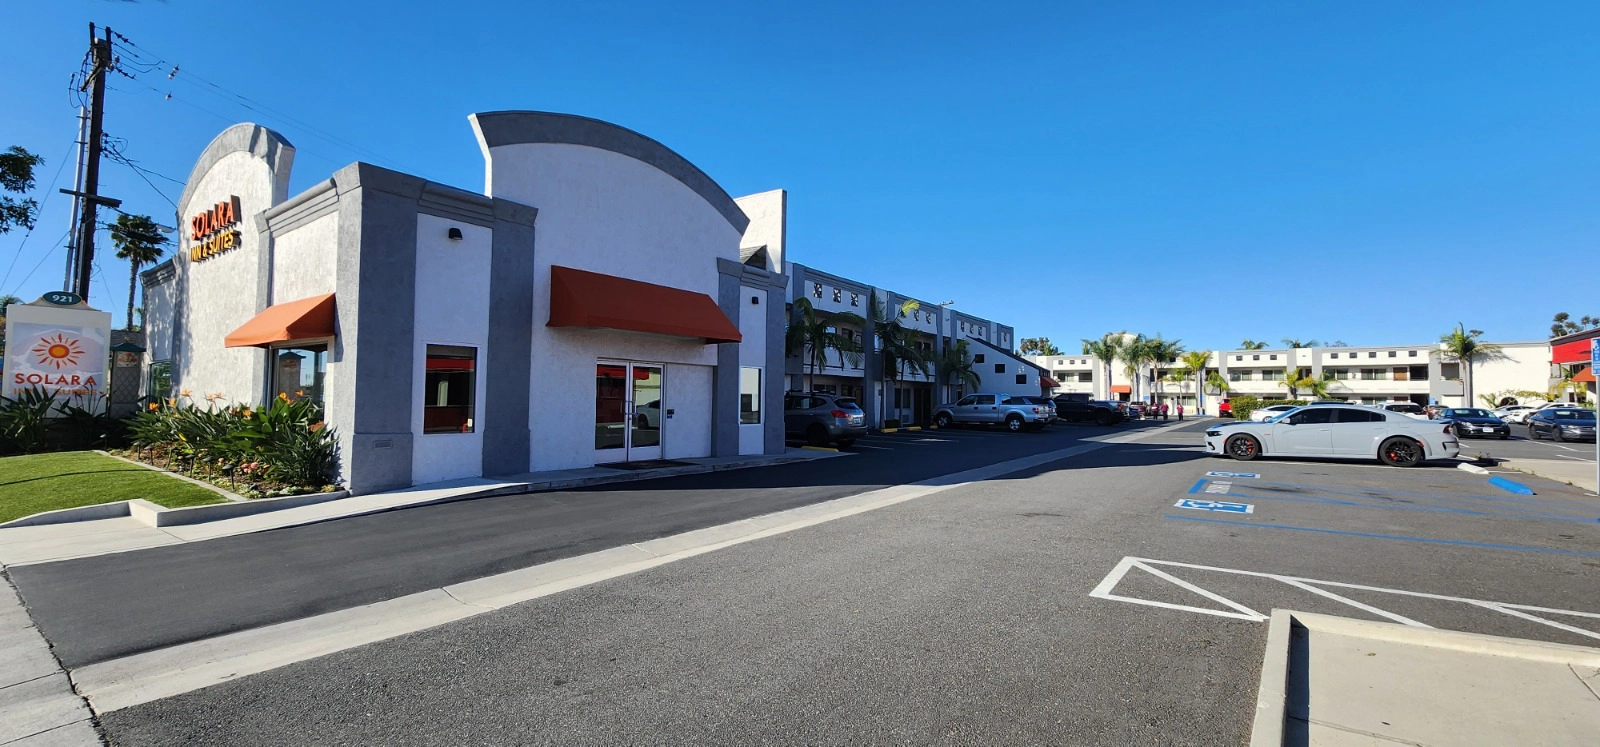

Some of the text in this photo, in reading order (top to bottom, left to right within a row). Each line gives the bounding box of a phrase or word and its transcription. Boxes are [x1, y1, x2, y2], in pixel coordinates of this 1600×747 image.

[191, 196, 235, 240] SOLARA
[190, 245, 202, 262] INN
[208, 229, 234, 255] SUITES
[52, 294, 73, 302] 921
[14, 373, 97, 386] SOLARA
